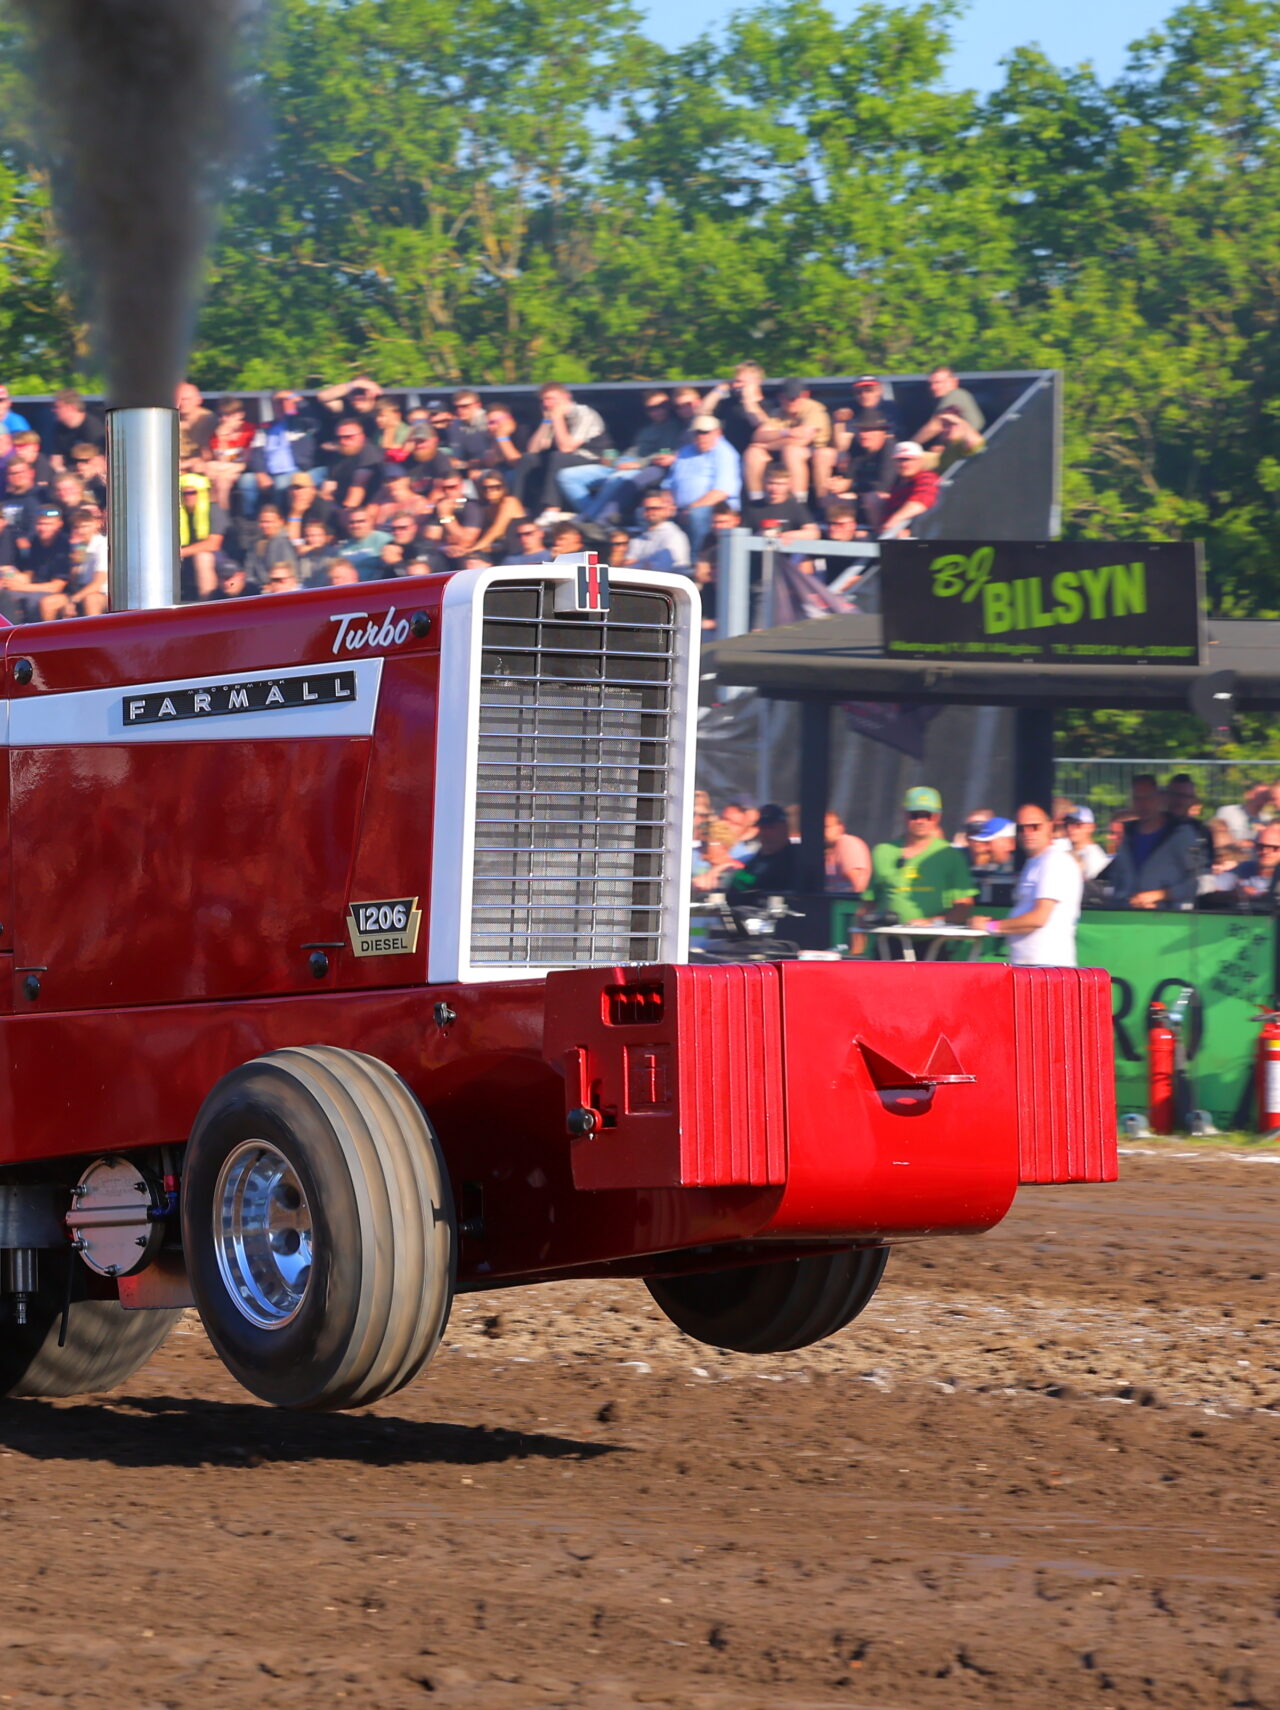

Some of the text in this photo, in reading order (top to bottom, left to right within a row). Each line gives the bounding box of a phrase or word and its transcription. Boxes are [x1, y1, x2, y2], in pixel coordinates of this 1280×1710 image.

[983, 562, 1147, 634] BILSYN
[330, 606, 409, 654] Turbo
[129, 678, 351, 720] FARMALL
[360, 904, 407, 931] 1206
[361, 938, 408, 952] DIESEL
